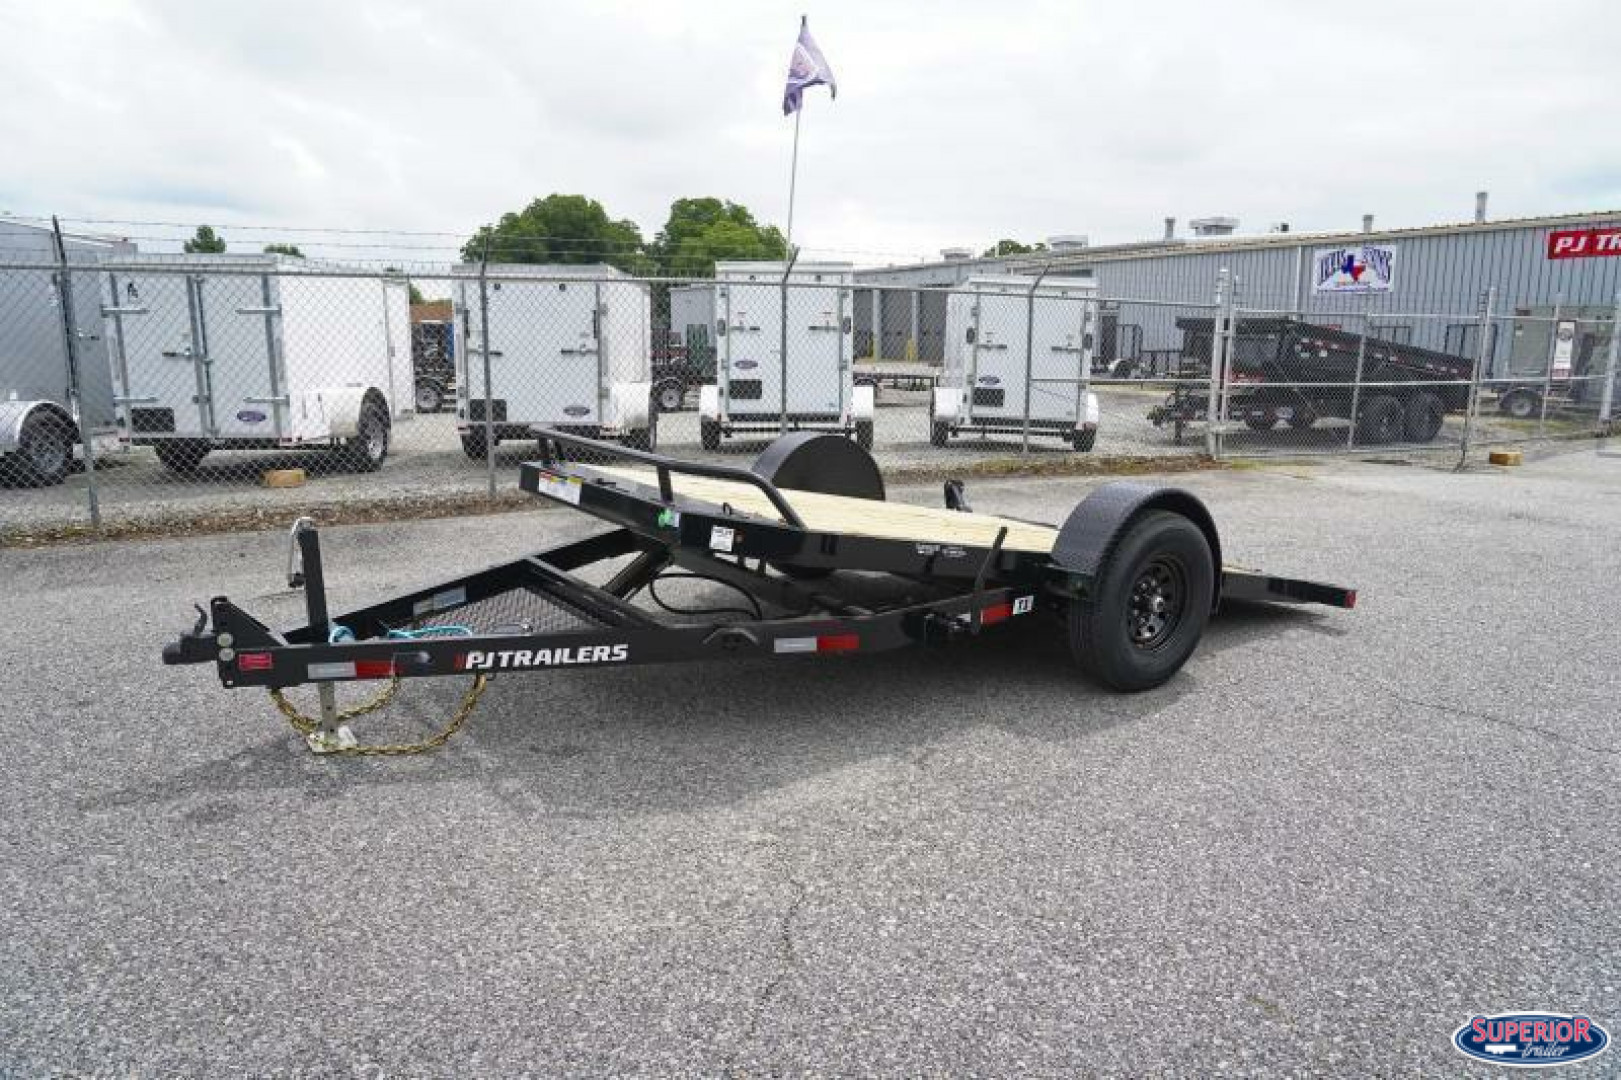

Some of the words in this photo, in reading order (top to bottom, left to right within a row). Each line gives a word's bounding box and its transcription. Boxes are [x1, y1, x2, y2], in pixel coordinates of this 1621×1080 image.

[1554, 236, 1587, 253] PJ
[465, 651, 495, 669] PJ
[497, 643, 629, 668] TRAILERS
